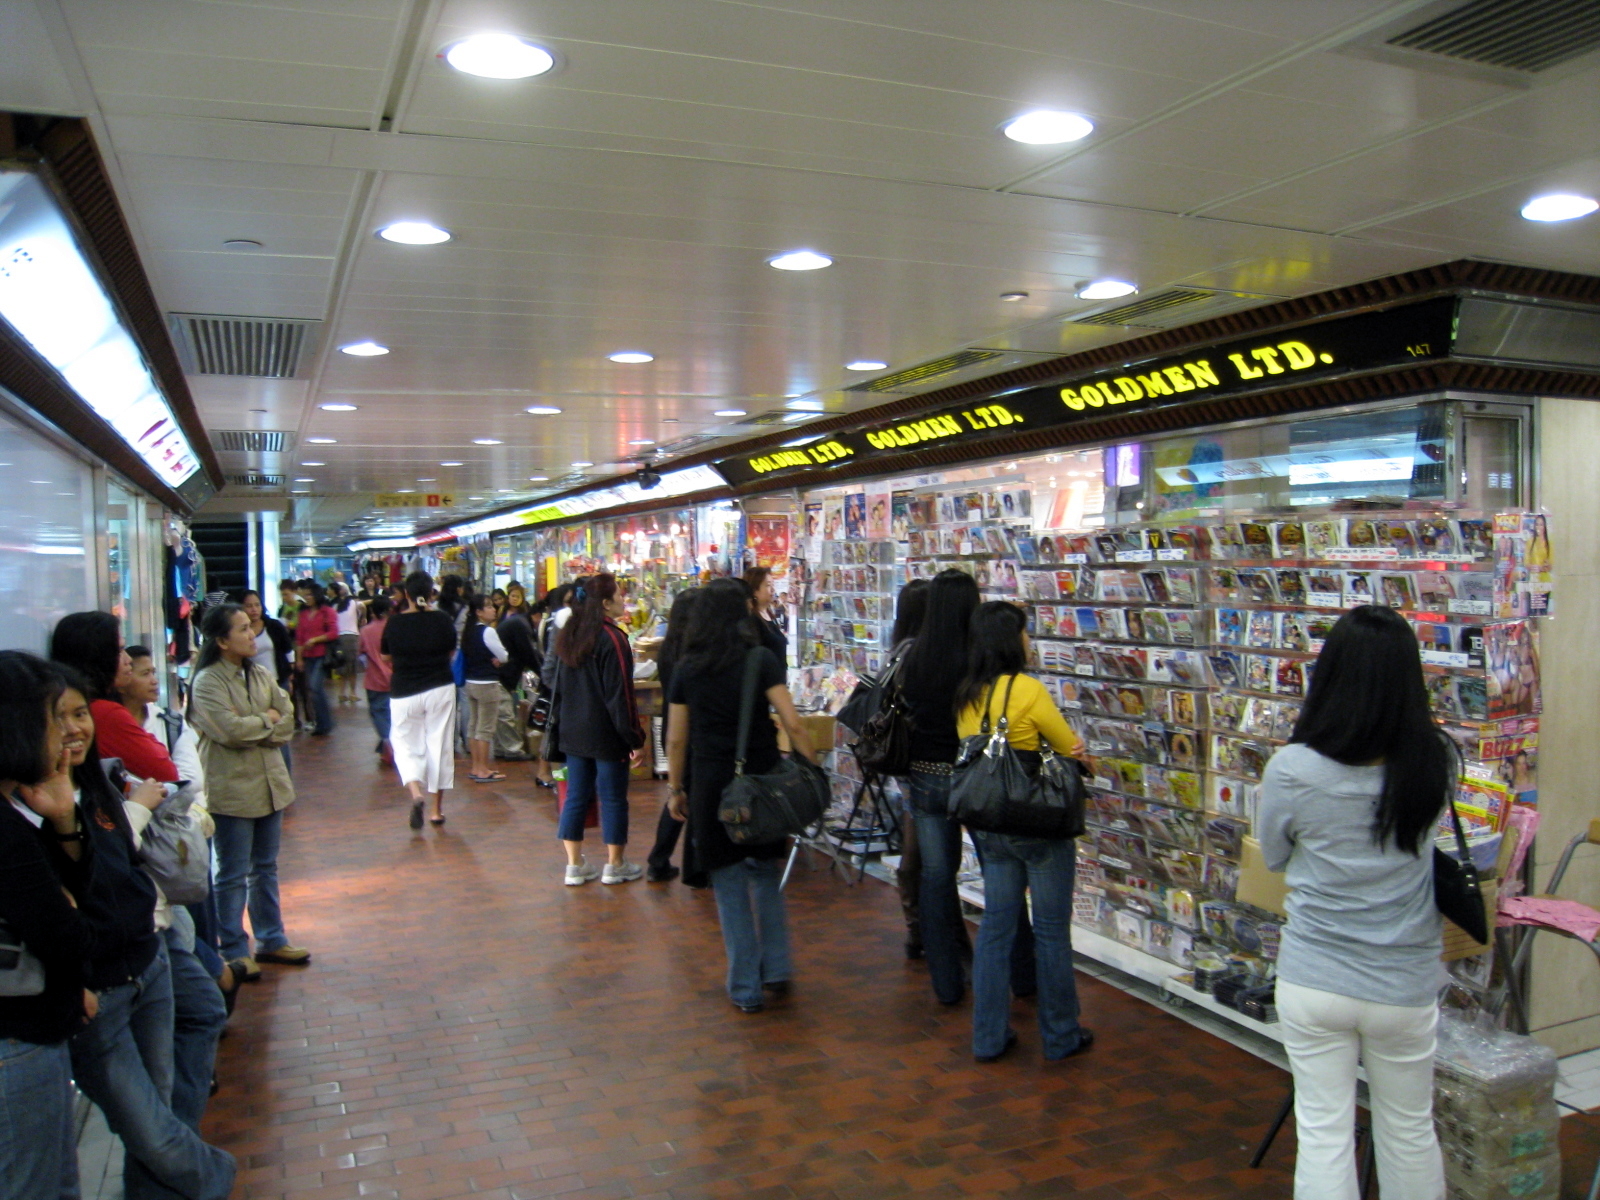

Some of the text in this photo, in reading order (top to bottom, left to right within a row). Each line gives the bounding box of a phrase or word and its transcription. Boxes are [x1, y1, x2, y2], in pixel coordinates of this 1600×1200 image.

[1406, 343, 1431, 358] 147
[1060, 340, 1334, 411] GOLDMEN LTD.
[865, 404, 1024, 450] GOLDMEN LTD.
[748, 440, 855, 474] GOLDMEN LTD.
[1481, 738, 1525, 758] BUZZ
